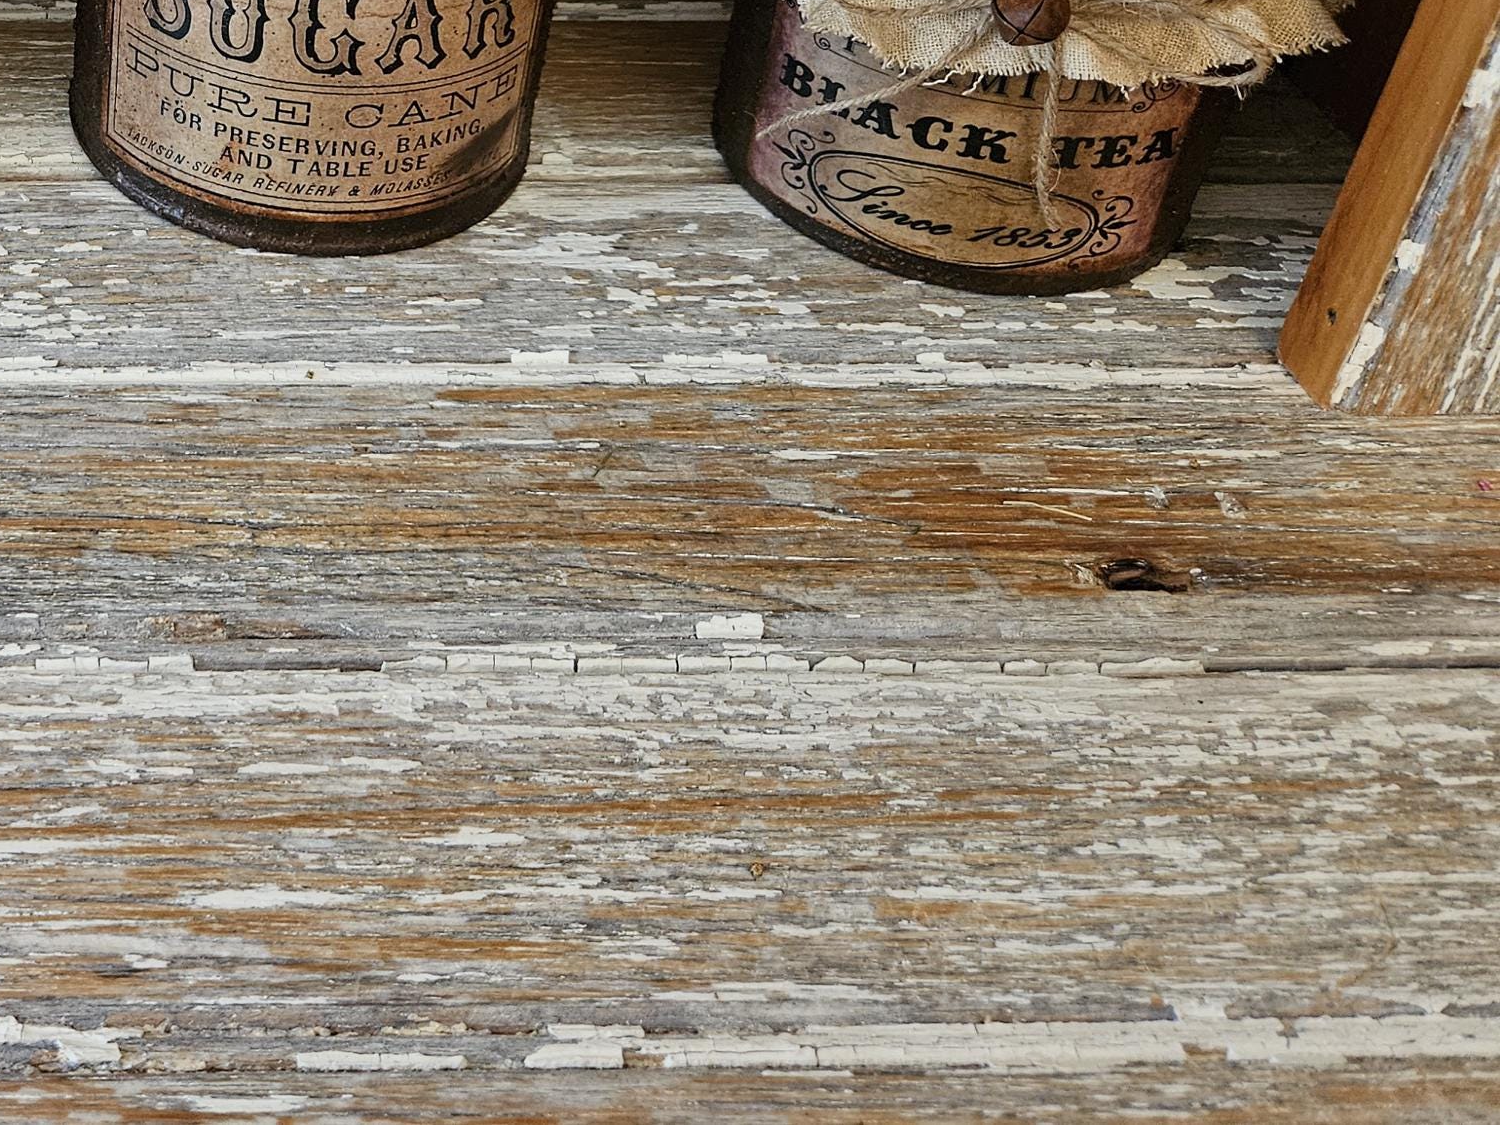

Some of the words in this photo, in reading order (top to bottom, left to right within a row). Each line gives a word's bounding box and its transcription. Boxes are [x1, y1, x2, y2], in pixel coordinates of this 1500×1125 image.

[126, 42, 311, 128] PURE
[344, 65, 518, 128] CANE
[779, 53, 1017, 164] BLACK
[1050, 127, 1179, 169] TEA
[160, 99, 201, 131] FOR
[214, 122, 384, 160] PRESERVING,
[219, 146, 272, 171] AND
[286, 158, 373, 177] TABLE
[384, 153, 430, 175] USE
[348, 185, 360, 196] &
[819, 169, 954, 236] Since
